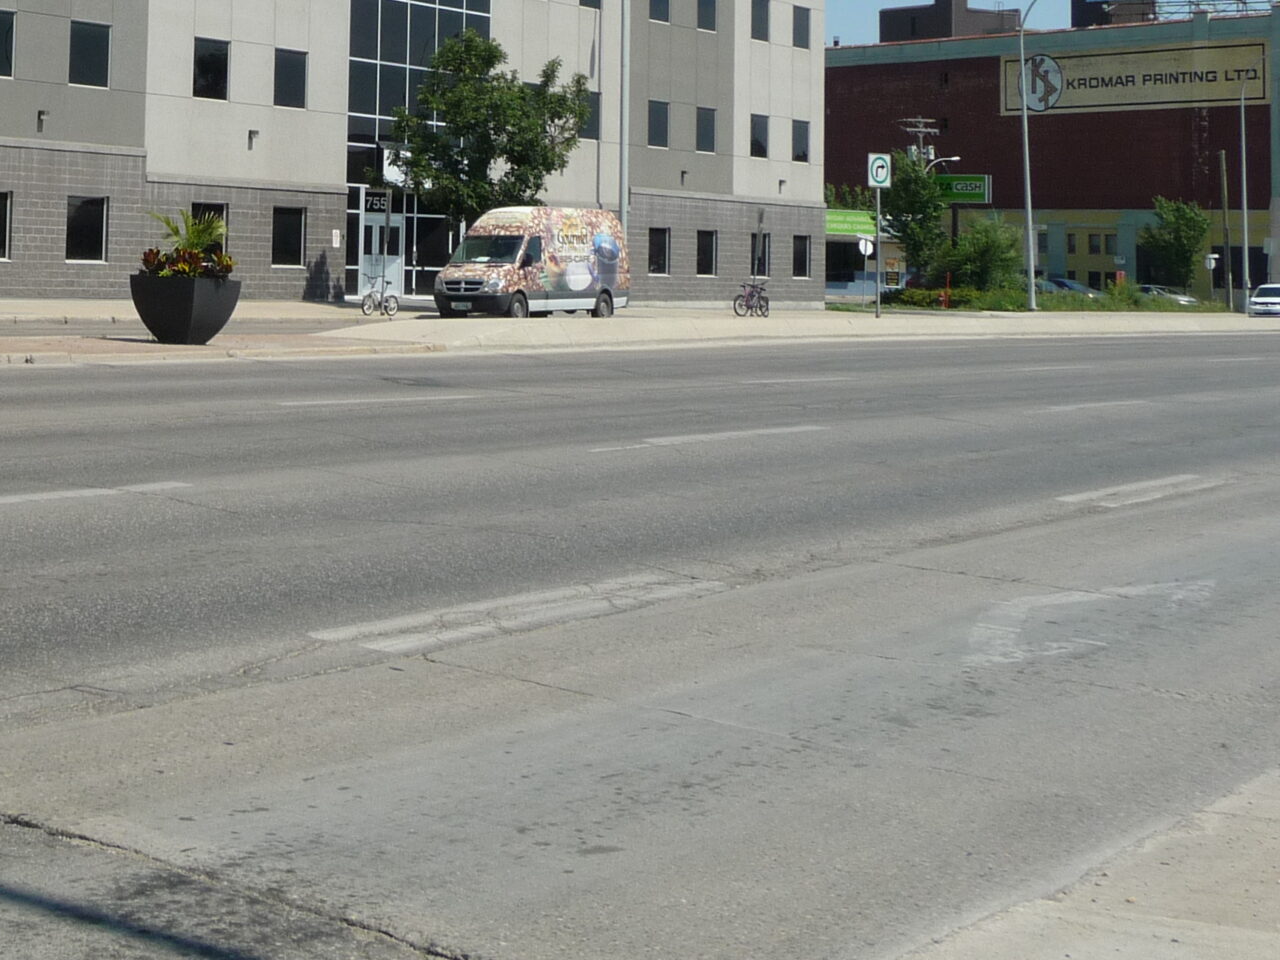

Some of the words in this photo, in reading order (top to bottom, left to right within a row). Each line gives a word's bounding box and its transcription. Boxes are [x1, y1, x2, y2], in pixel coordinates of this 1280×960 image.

[1066, 75, 1136, 90] KROMAR
[1142, 70, 1217, 86] PRINTING
[366, 197, 387, 209] 755
